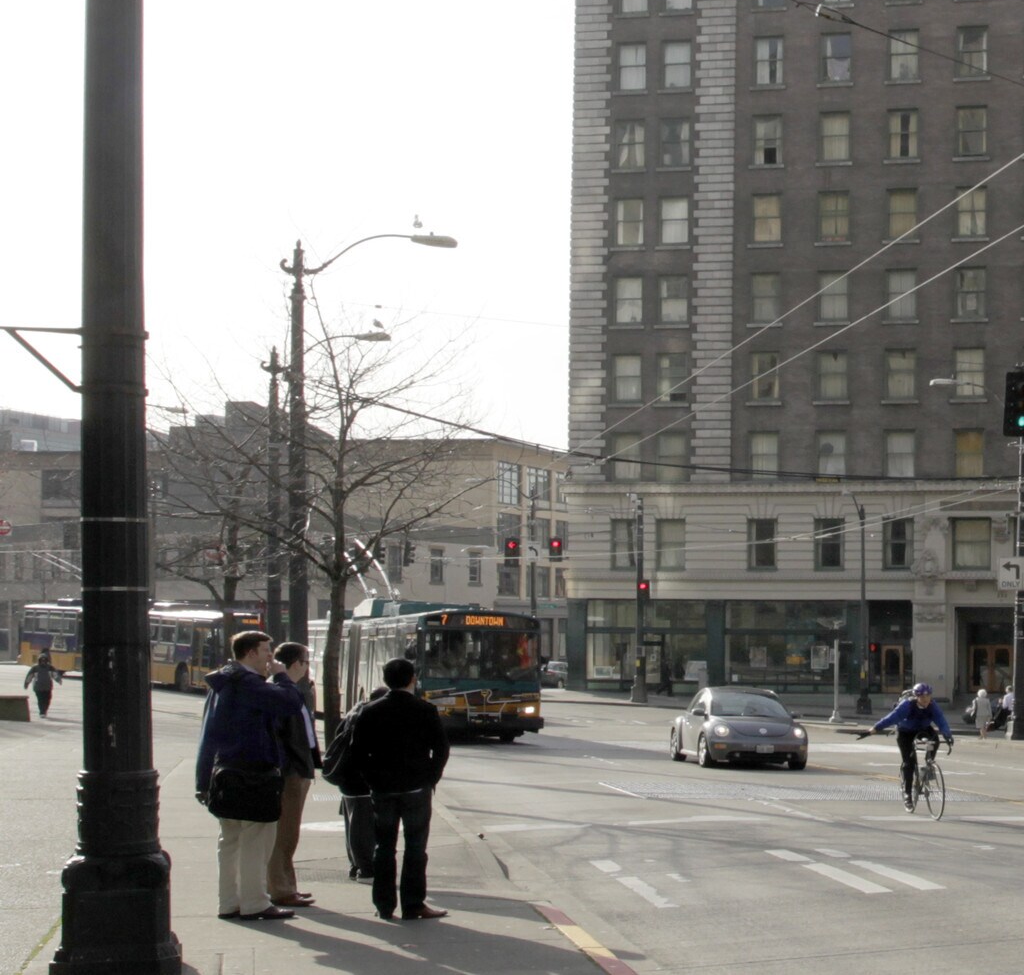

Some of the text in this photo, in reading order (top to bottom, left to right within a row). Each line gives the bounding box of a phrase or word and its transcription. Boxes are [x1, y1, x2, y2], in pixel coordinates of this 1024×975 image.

[1001, 580, 1020, 588] ONLY
[441, 614, 504, 626] 7 DOWNTOWN
